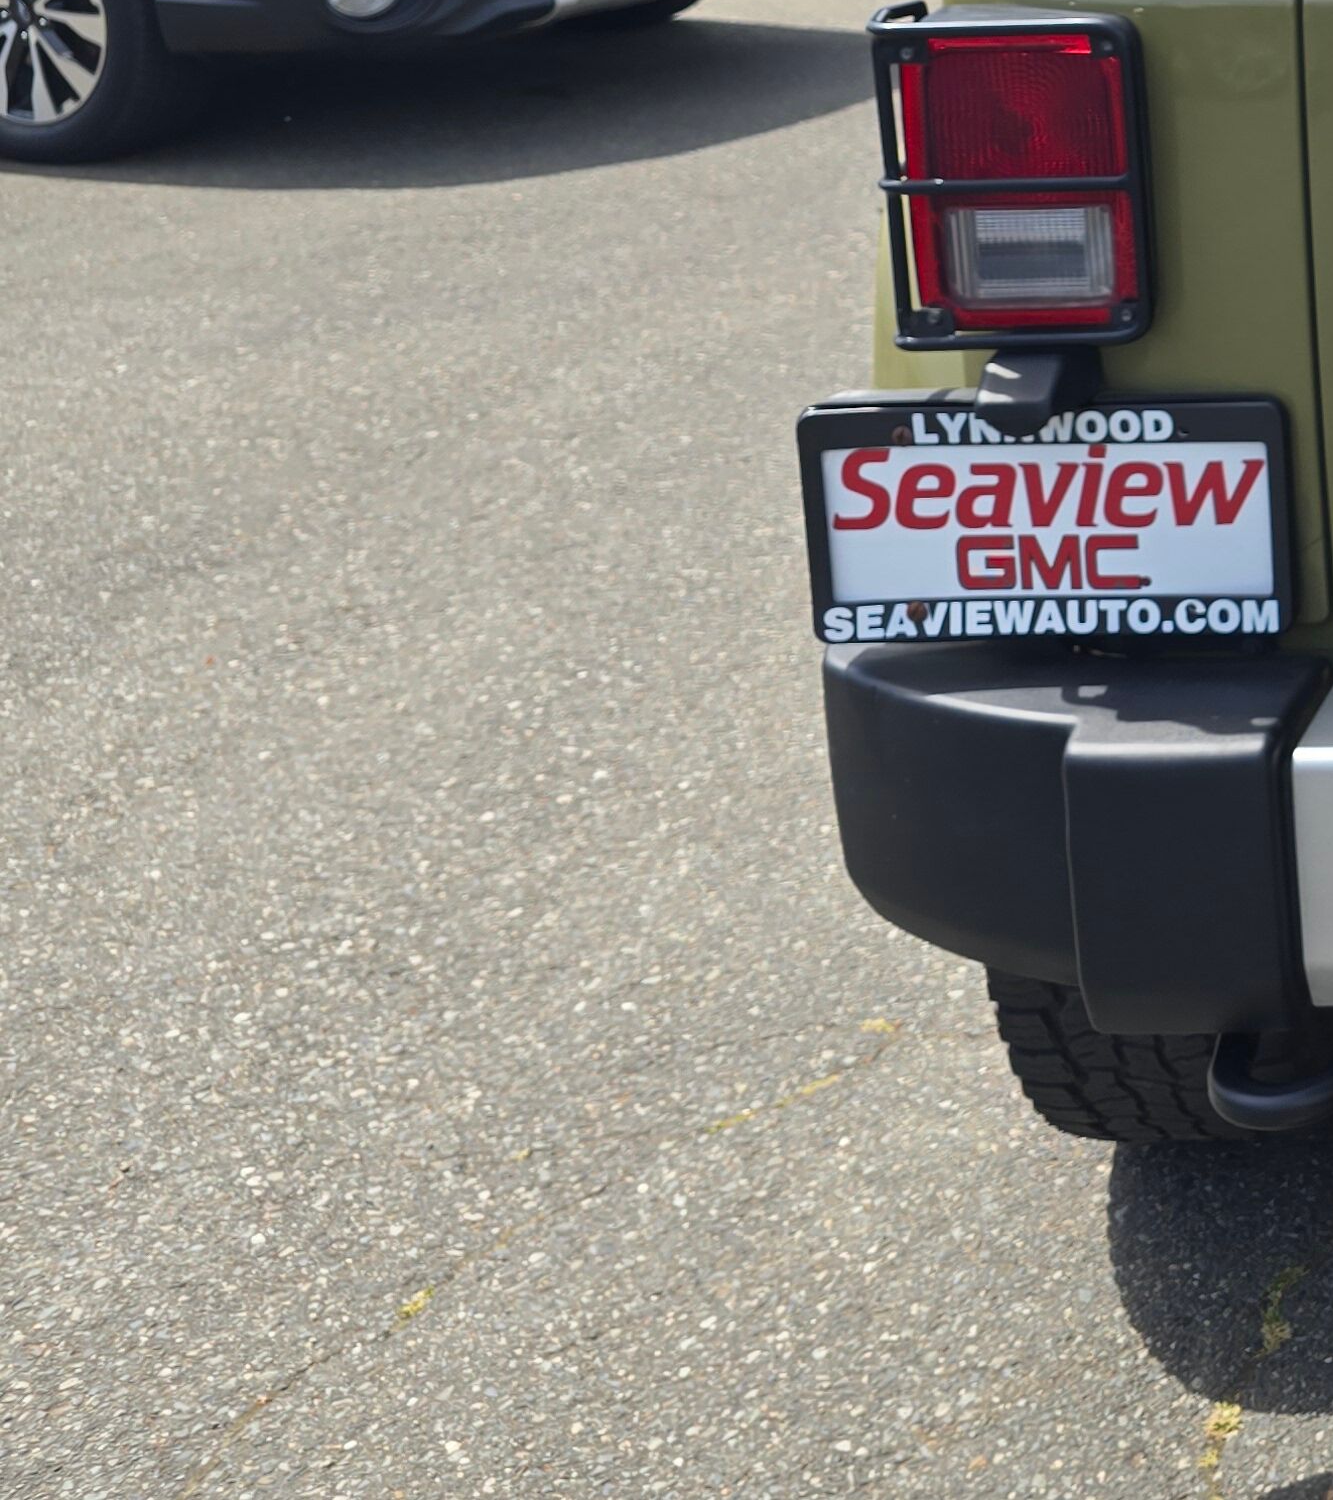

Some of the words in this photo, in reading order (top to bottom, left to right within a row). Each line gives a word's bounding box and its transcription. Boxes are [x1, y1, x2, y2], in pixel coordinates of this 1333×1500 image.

[911, 409, 1174, 445] LYNWOOD
[833, 444, 1266, 531] Seaview
[956, 534, 1150, 591] GMC
[823, 599, 1280, 643] SEAVIEWAUTO.COM
